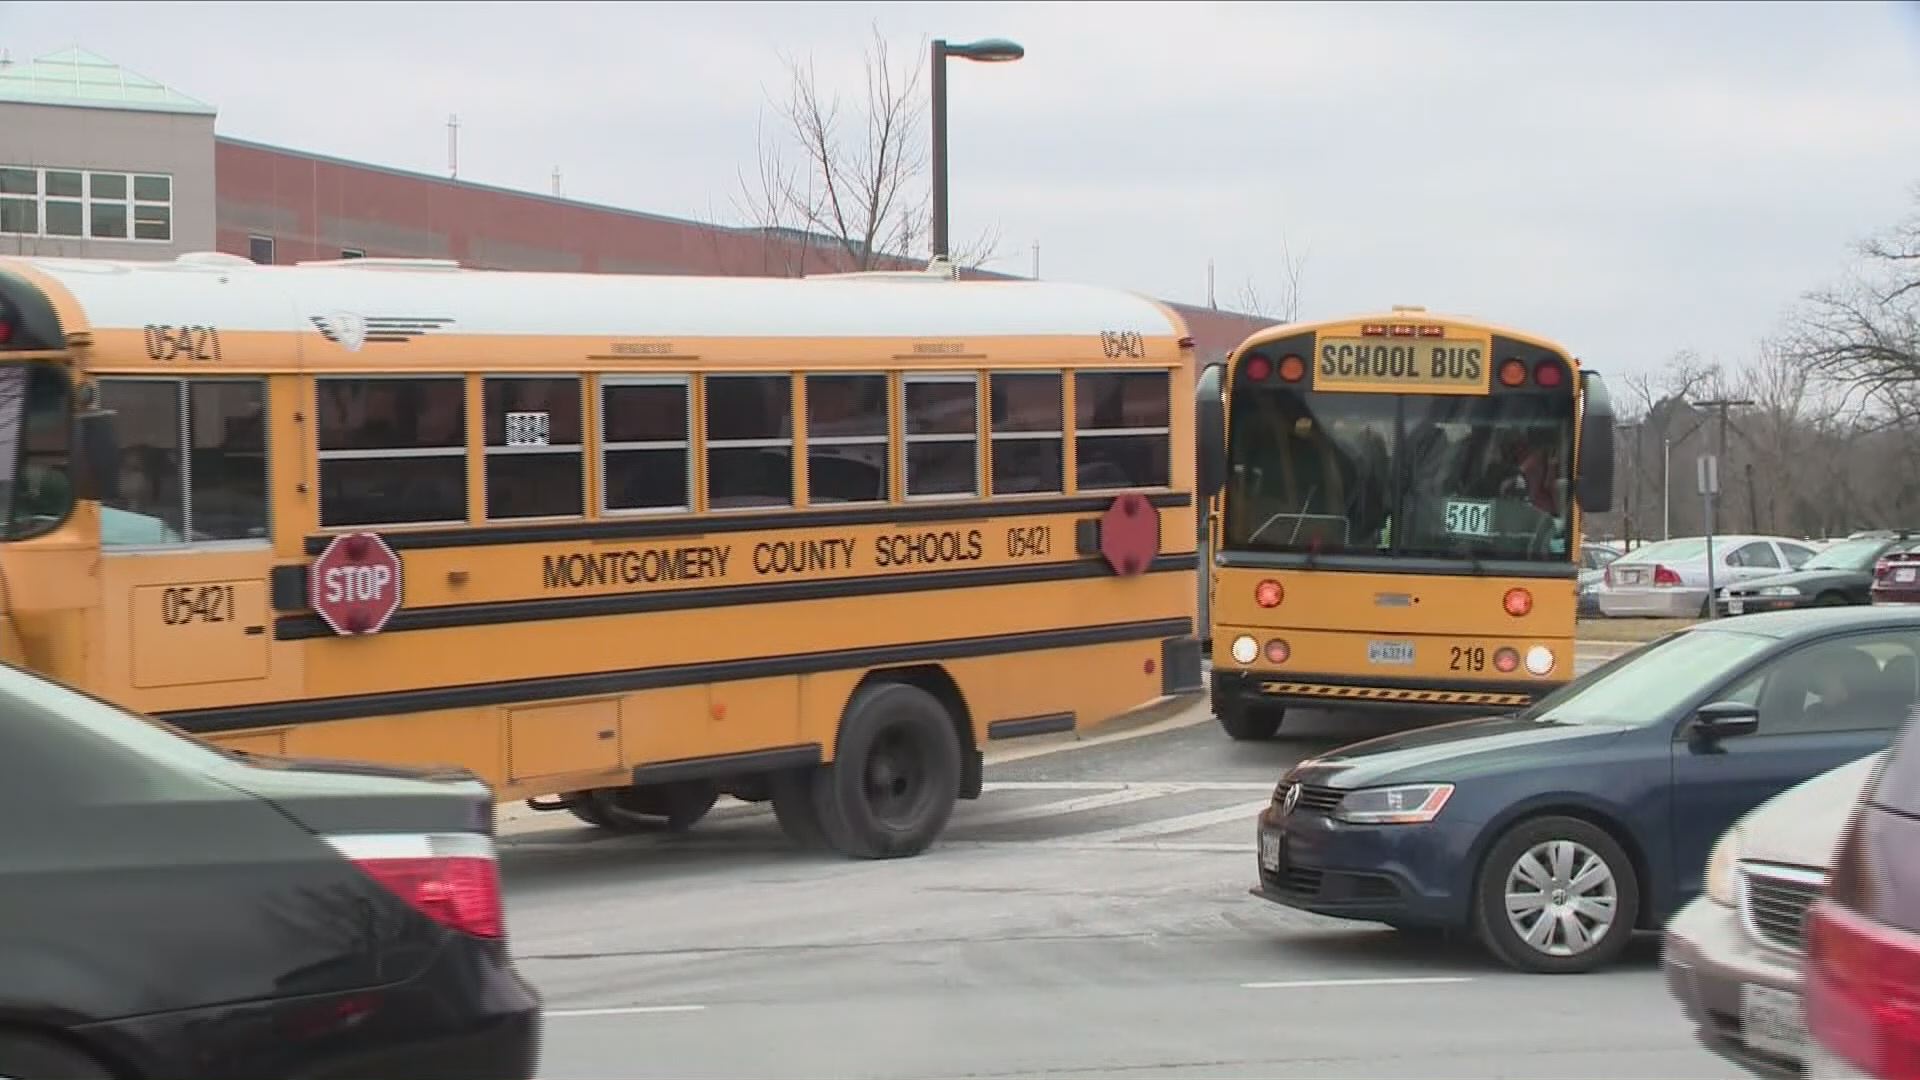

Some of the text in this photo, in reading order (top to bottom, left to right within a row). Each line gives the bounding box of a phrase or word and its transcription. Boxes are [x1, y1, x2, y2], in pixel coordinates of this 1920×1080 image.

[144, 324, 222, 360] 05421
[1100, 331, 1145, 358] 05421
[1321, 345, 1481, 378] SCHOOL BUS
[1447, 505, 1489, 532] 5101
[543, 526, 1051, 588] MONTGOMERY COUNTY SCHOOLS 05421
[324, 565, 391, 603] STOP
[162, 586, 235, 624] 05421
[1449, 646, 1484, 671] 219
